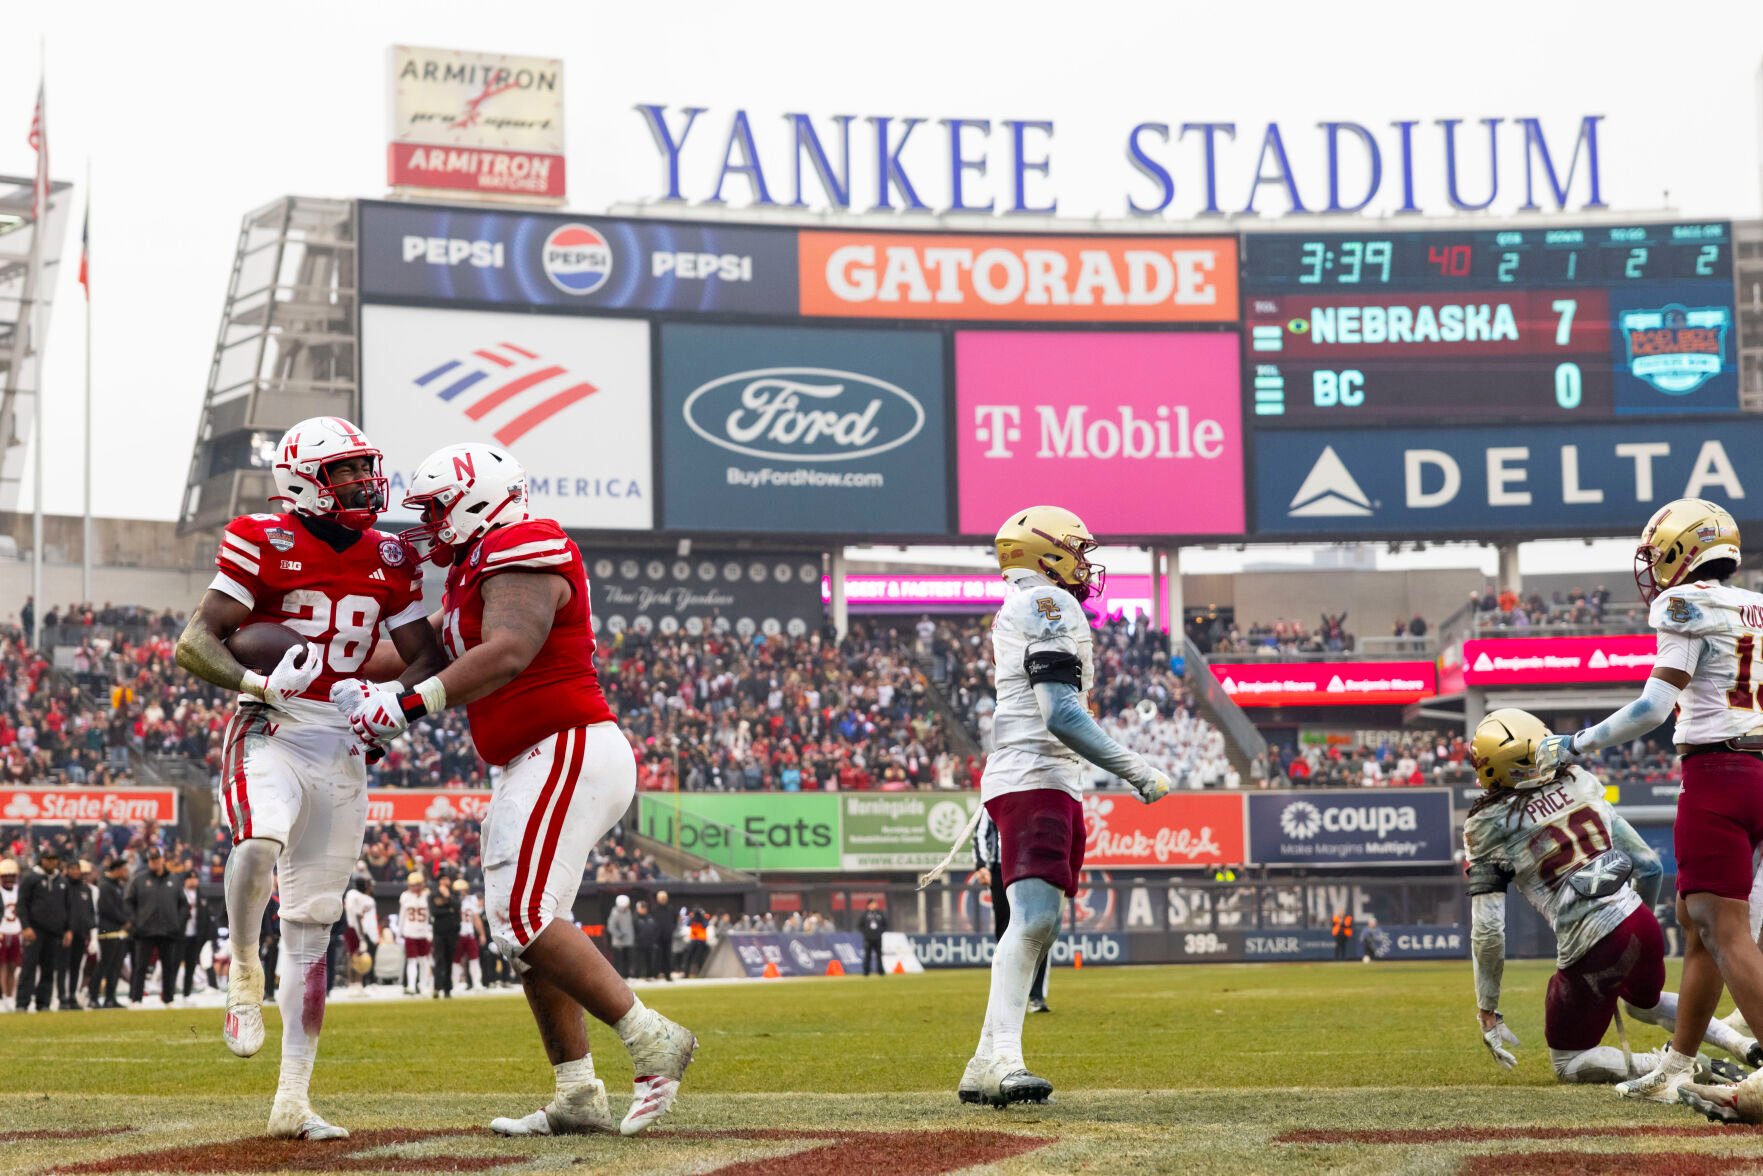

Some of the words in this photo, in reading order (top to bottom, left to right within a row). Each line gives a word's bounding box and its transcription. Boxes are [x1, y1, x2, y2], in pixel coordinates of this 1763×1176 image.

[400, 60, 557, 91] ARMITRON
[407, 148, 551, 178] ARMITRON
[633, 104, 1057, 214] YANKEE
[1126, 115, 1608, 217] STADIUM
[402, 235, 505, 268] PEPSI
[549, 249, 607, 268] PEPSI
[652, 251, 753, 282] PEPSI
[825, 245, 1217, 305] GATORADE
[1299, 241, 1392, 283] 3:39
[1428, 245, 1471, 277] 40
[1498, 252, 1519, 281] 2
[1567, 251, 1577, 280] 1
[1625, 247, 1648, 278] 2
[1696, 245, 1718, 275] 2
[1310, 304, 1519, 343] NEBRASKA
[1552, 299, 1577, 345] 7
[1313, 369, 1365, 407] BC
[1554, 361, 1582, 409] 0
[726, 378, 883, 446] Ford
[1036, 404, 1224, 459] Mobile
[452, 452, 476, 481] N
[727, 466, 884, 488] BuyFordNow.com
[1404, 439, 1746, 508] DELTA
[530, 477, 643, 498] MERICA
[281, 588, 384, 673] 28
[1726, 633, 1763, 711] 1
[262, 721, 279, 737] N
[1323, 806, 1417, 838] coupa
[1524, 786, 1575, 824] PRICE
[648, 814, 735, 849] Uber
[743, 816, 833, 848] Eats
[1280, 843, 1313, 856] Make
[1528, 802, 1613, 891] 20
[1127, 877, 1154, 925] A
[911, 936, 997, 962] tubHub
[1183, 933, 1218, 954] 399
[1245, 937, 1299, 954] STARR
[1397, 934, 1462, 951] CLEAR
